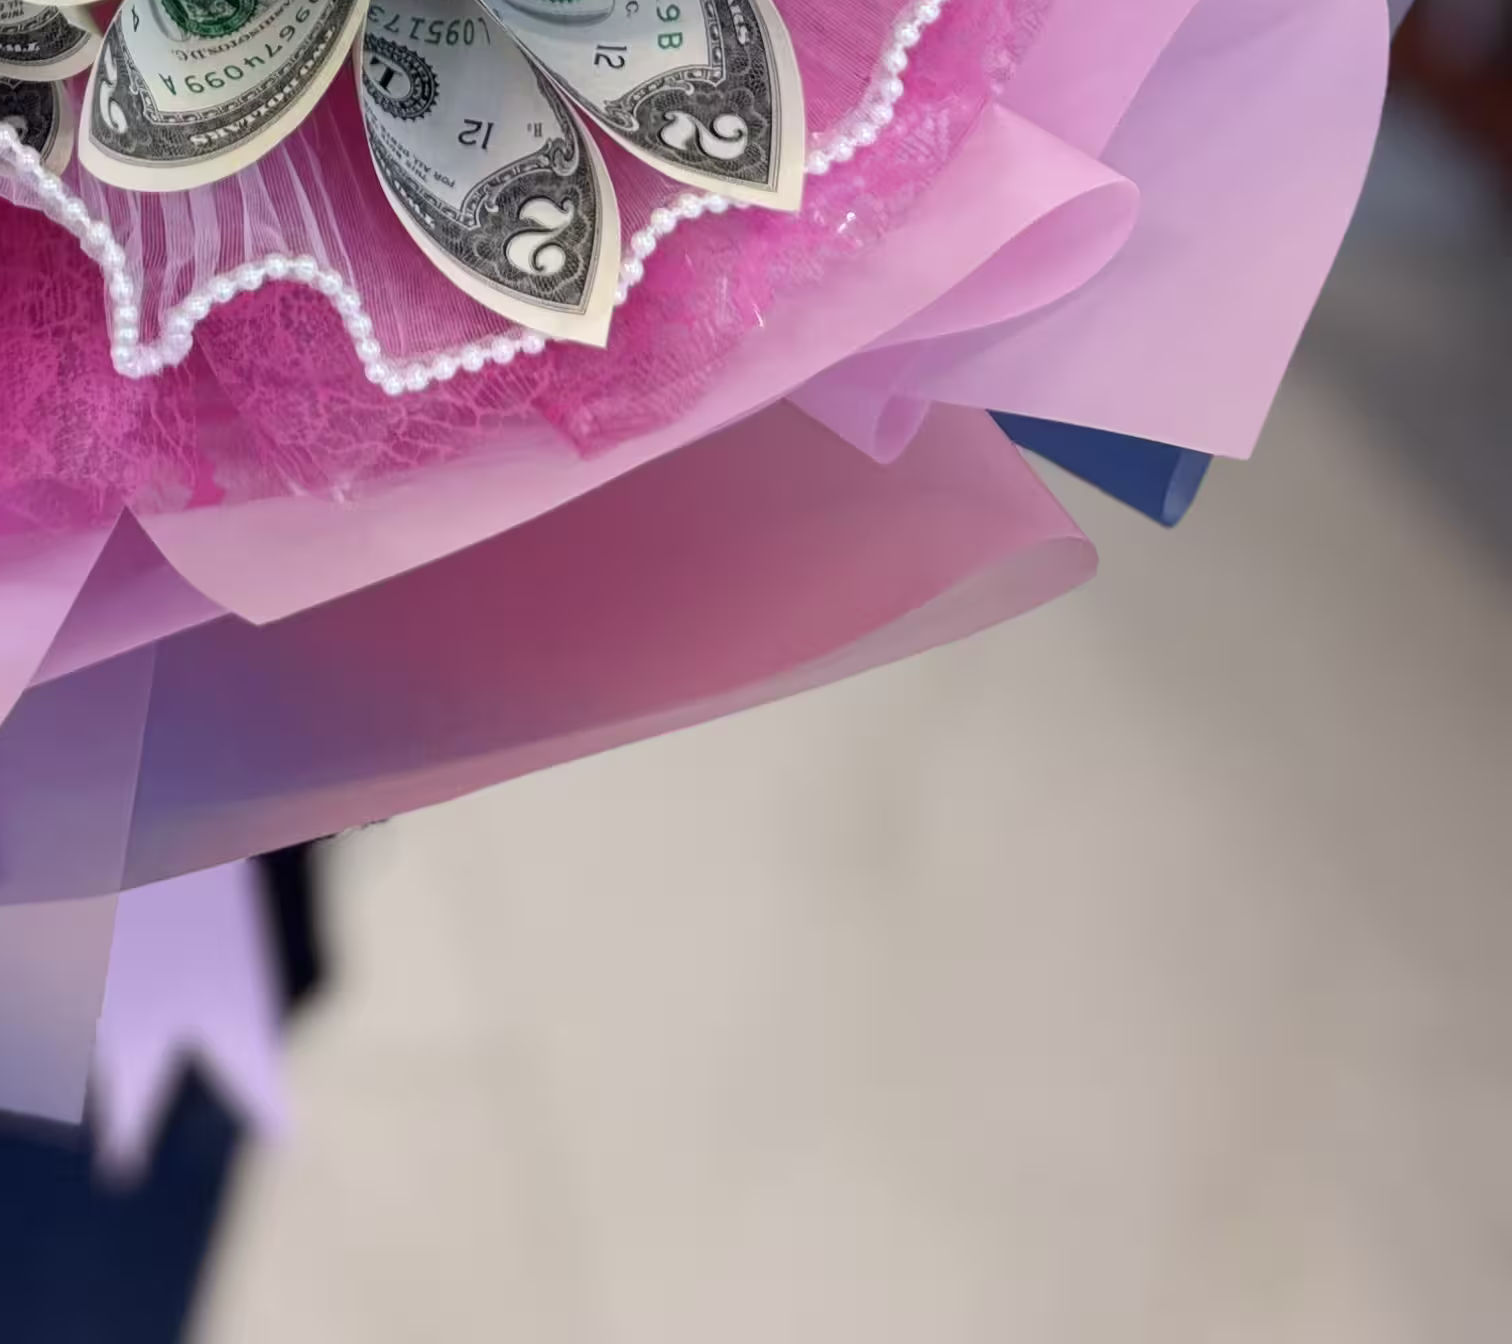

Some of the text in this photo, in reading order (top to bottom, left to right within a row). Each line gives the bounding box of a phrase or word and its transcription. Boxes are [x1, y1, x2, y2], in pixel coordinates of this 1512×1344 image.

[592, 43, 629, 70] 12
[656, 30, 685, 52] B
[457, 118, 496, 151] 12
[659, 111, 749, 161] 2
[505, 196, 576, 278] 2
